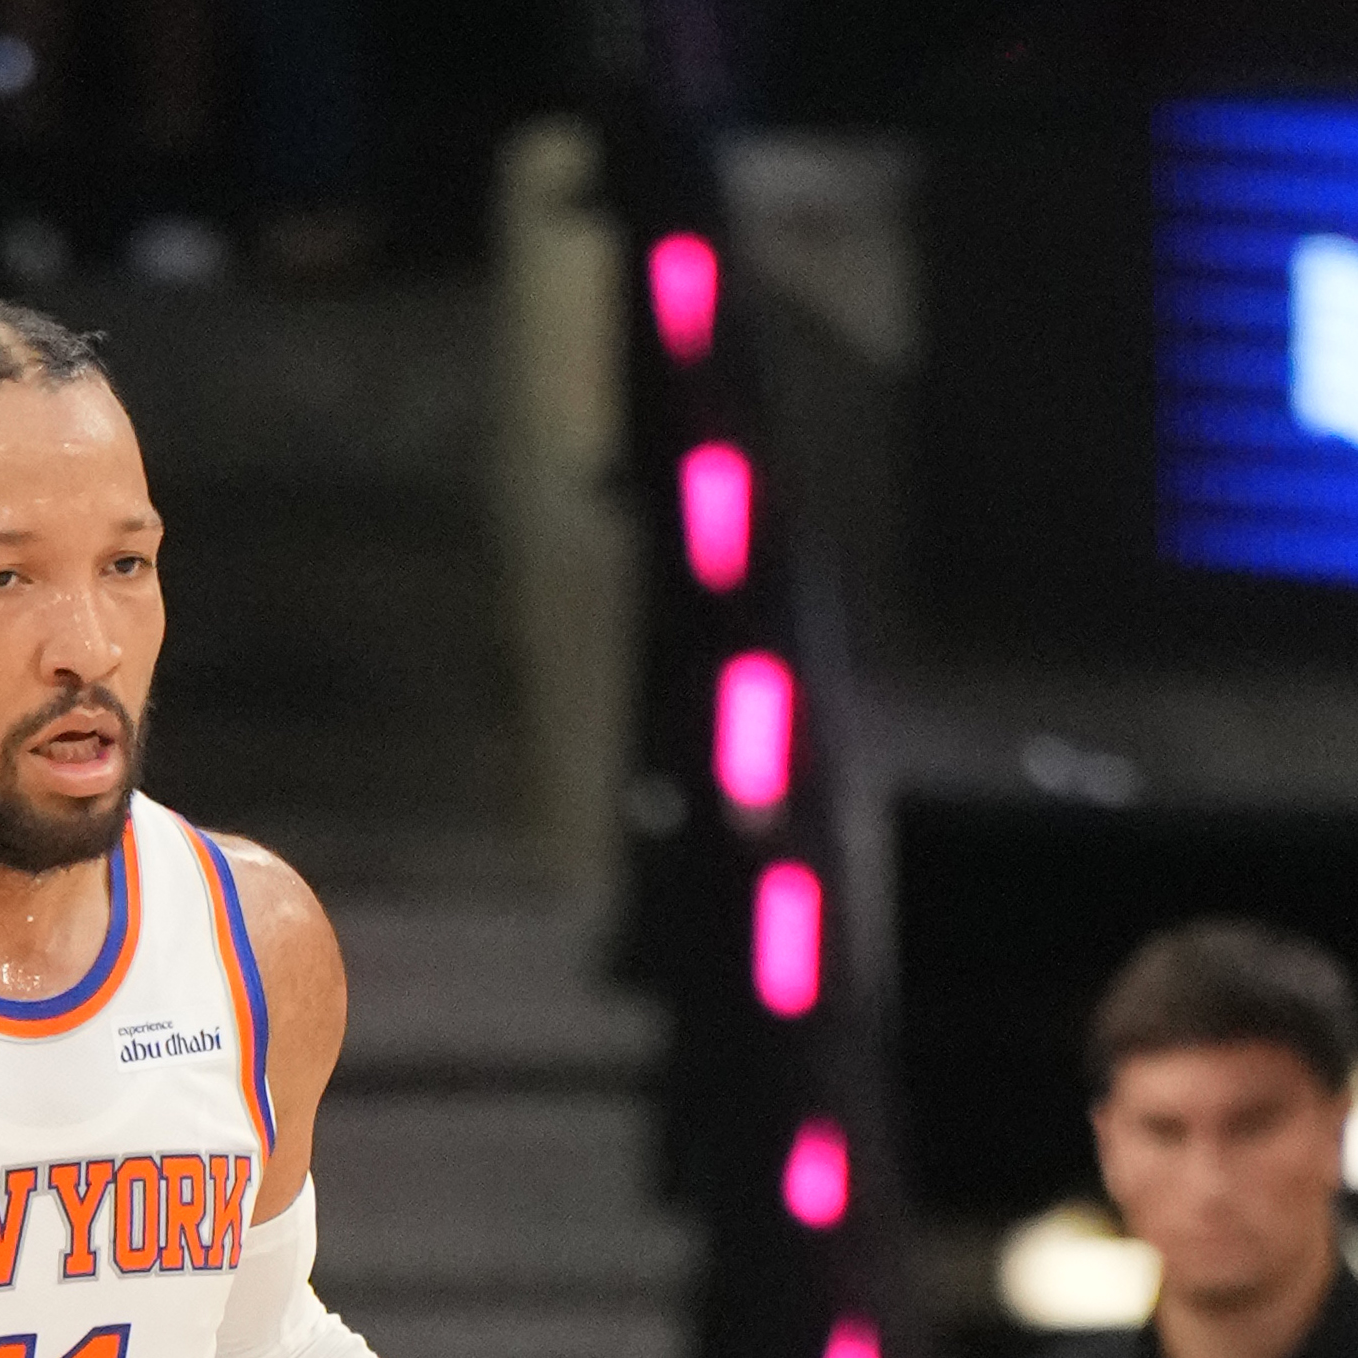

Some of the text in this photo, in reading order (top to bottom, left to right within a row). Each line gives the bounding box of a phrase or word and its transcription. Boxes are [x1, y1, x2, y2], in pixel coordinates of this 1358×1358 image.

[118, 1021, 173, 1037] experience
[120, 1039, 162, 1063] abu
[48, 1153, 251, 1279] YORK
